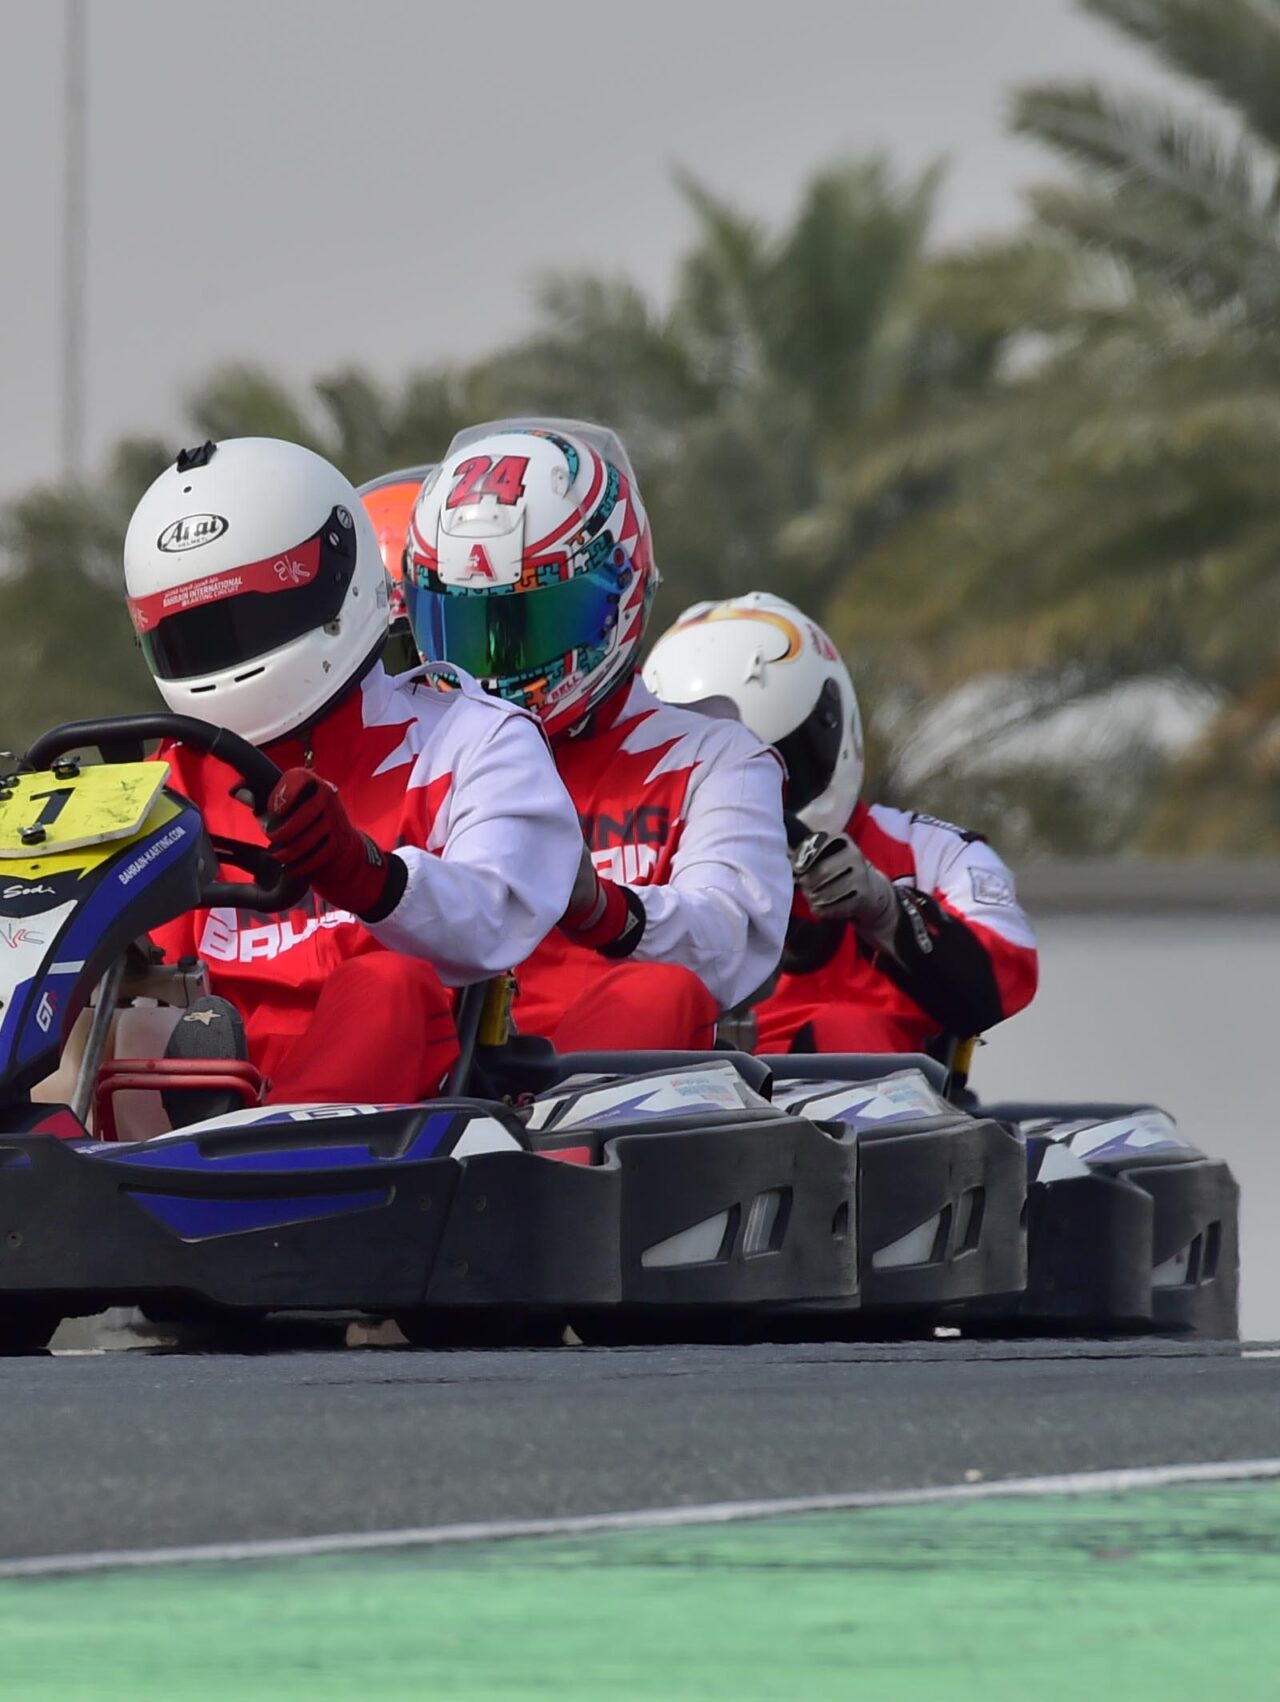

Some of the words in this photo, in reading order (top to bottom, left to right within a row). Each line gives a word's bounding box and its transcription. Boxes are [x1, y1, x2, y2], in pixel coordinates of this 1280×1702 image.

[446, 455, 530, 510] 24
[551, 675, 579, 701] BELL
[118, 826, 187, 885] BAHRAIN-KARTING.COM
